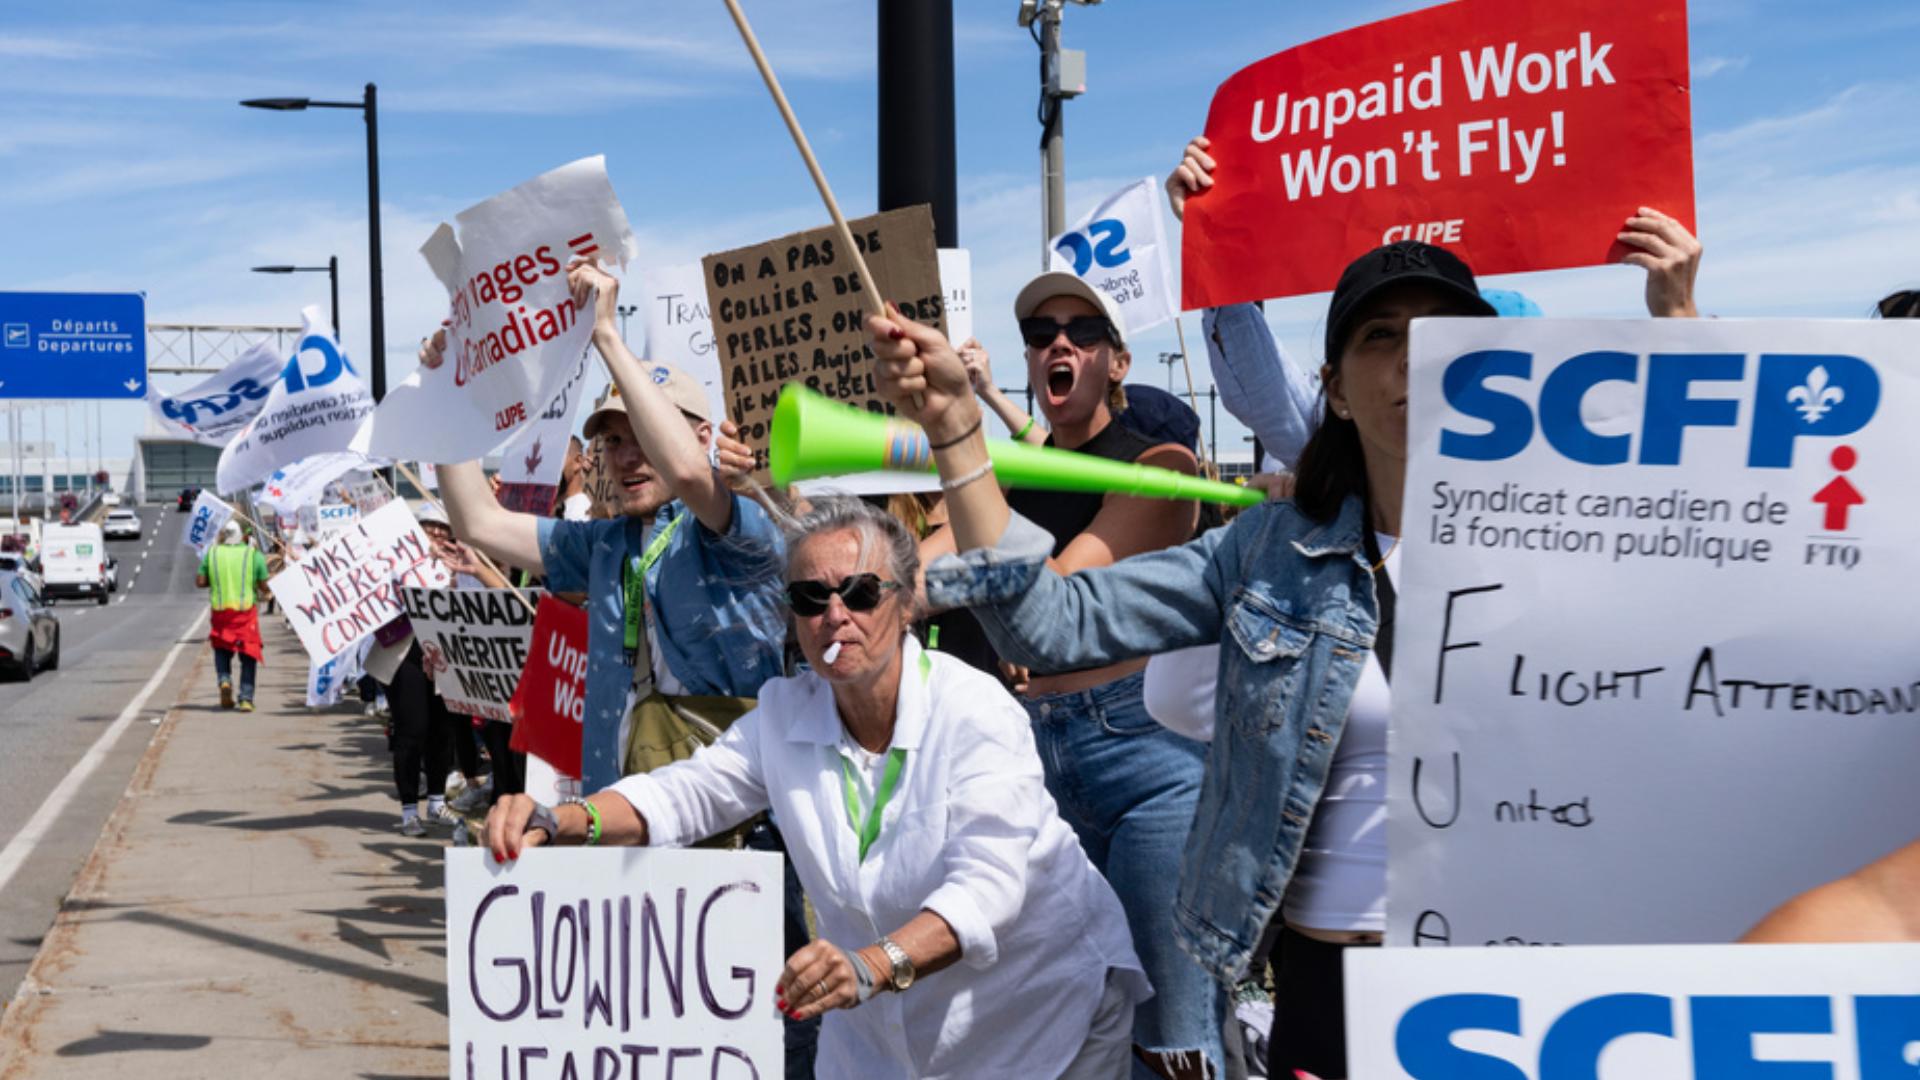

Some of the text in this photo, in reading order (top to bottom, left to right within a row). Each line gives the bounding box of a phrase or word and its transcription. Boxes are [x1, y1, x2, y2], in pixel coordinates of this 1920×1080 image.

[1250, 32, 1616, 142] Unpaid Work
[1281, 111, 1567, 201] Won't Fly!
[714, 230, 882, 288] ON A PAS DE
[833, 271, 862, 295] DE
[52, 318, 119, 334] Départs
[832, 309, 864, 333] ON
[38, 339, 134, 354] Departures
[738, 420, 772, 443] PO
[1438, 350, 1882, 468] SCFP
[1431, 481, 1789, 525] Syndicat canadien de
[1430, 515, 1772, 568] la fonction publique
[1804, 543, 1862, 570] FTQ
[402, 587, 430, 620] LE
[548, 629, 588, 686] Unp
[554, 678, 584, 723] Wo
[1684, 647, 1920, 717] ATTENDAN
[468, 881, 761, 1033] GLOWING
